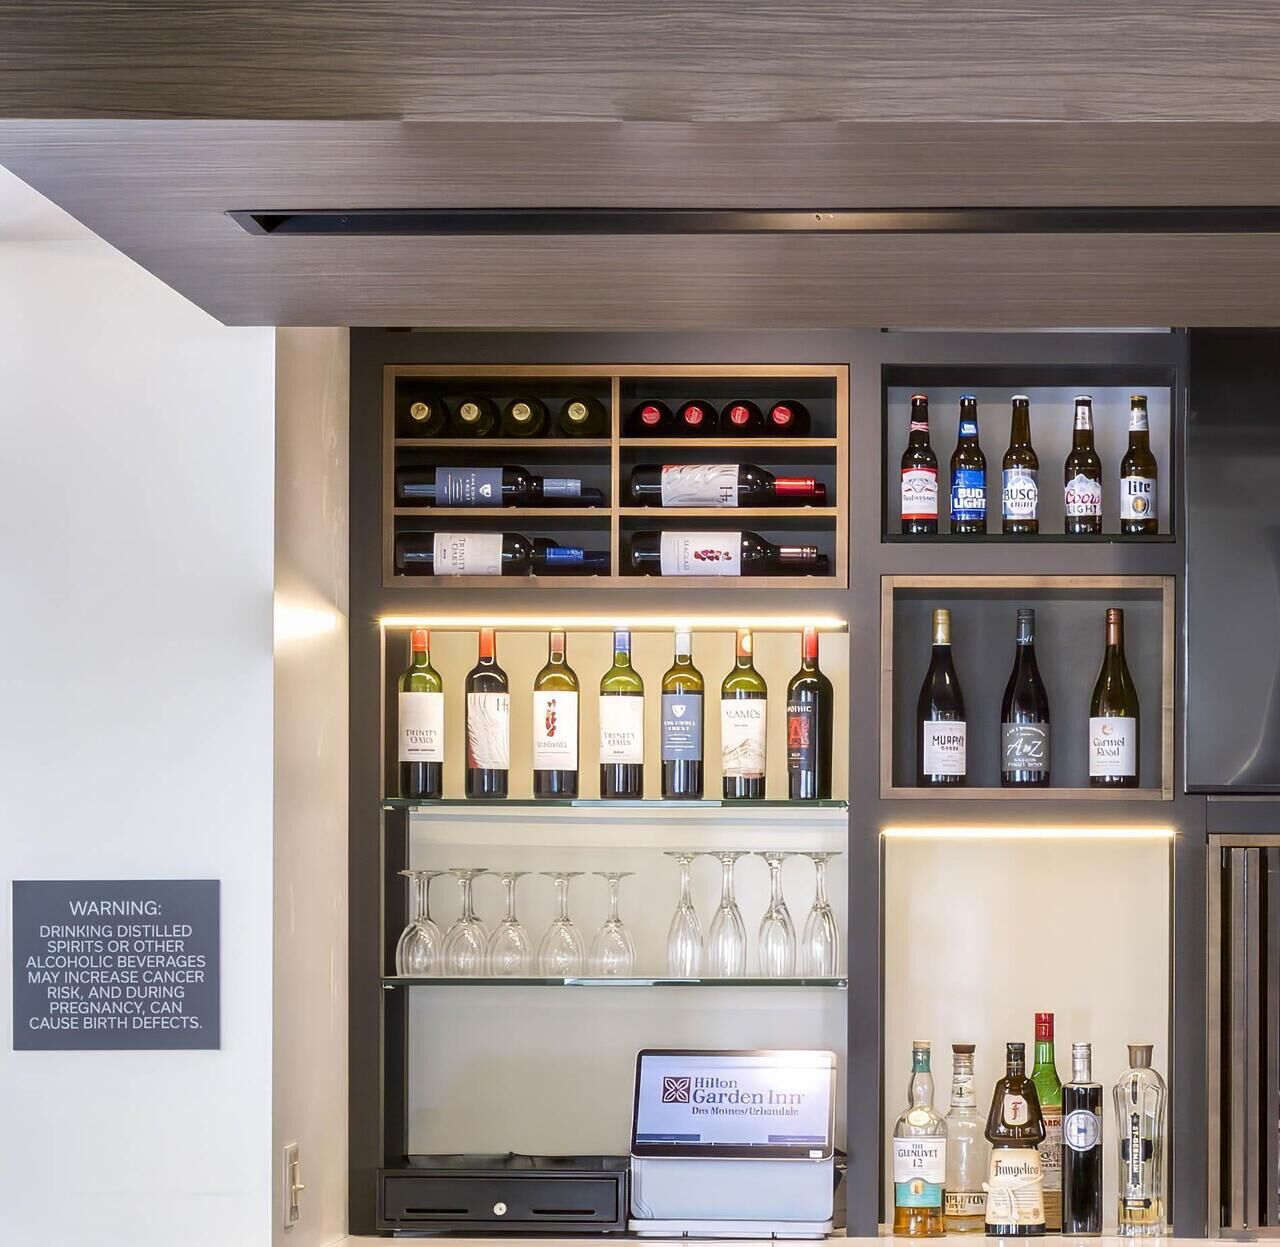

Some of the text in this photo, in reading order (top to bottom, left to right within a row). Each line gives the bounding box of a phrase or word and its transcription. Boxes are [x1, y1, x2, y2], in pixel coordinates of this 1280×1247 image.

[958, 488, 984, 498] BUD
[1128, 480, 1151, 496] Lite
[953, 498, 986, 509] LIGHT
[69, 901, 162, 916] WARNING:
[40, 925, 193, 938] DRINKING DISTILLED
[47, 940, 184, 953] SPIRITS OR OTHER
[26, 955, 206, 968] ALCOHOLIC BEVERAGES
[28, 971, 204, 984] MAY INCREASE CANCER
[47, 986, 185, 1000] RISK, AND DURING
[49, 1001, 183, 1015] PREGNANCY, CAN
[29, 1017, 203, 1029] CAUSE BIRTH DEFECTS.
[694, 1077, 737, 1088] Hilton
[692, 1089, 801, 1104] Garden Inn
[912, 1159, 923, 1168] 12
